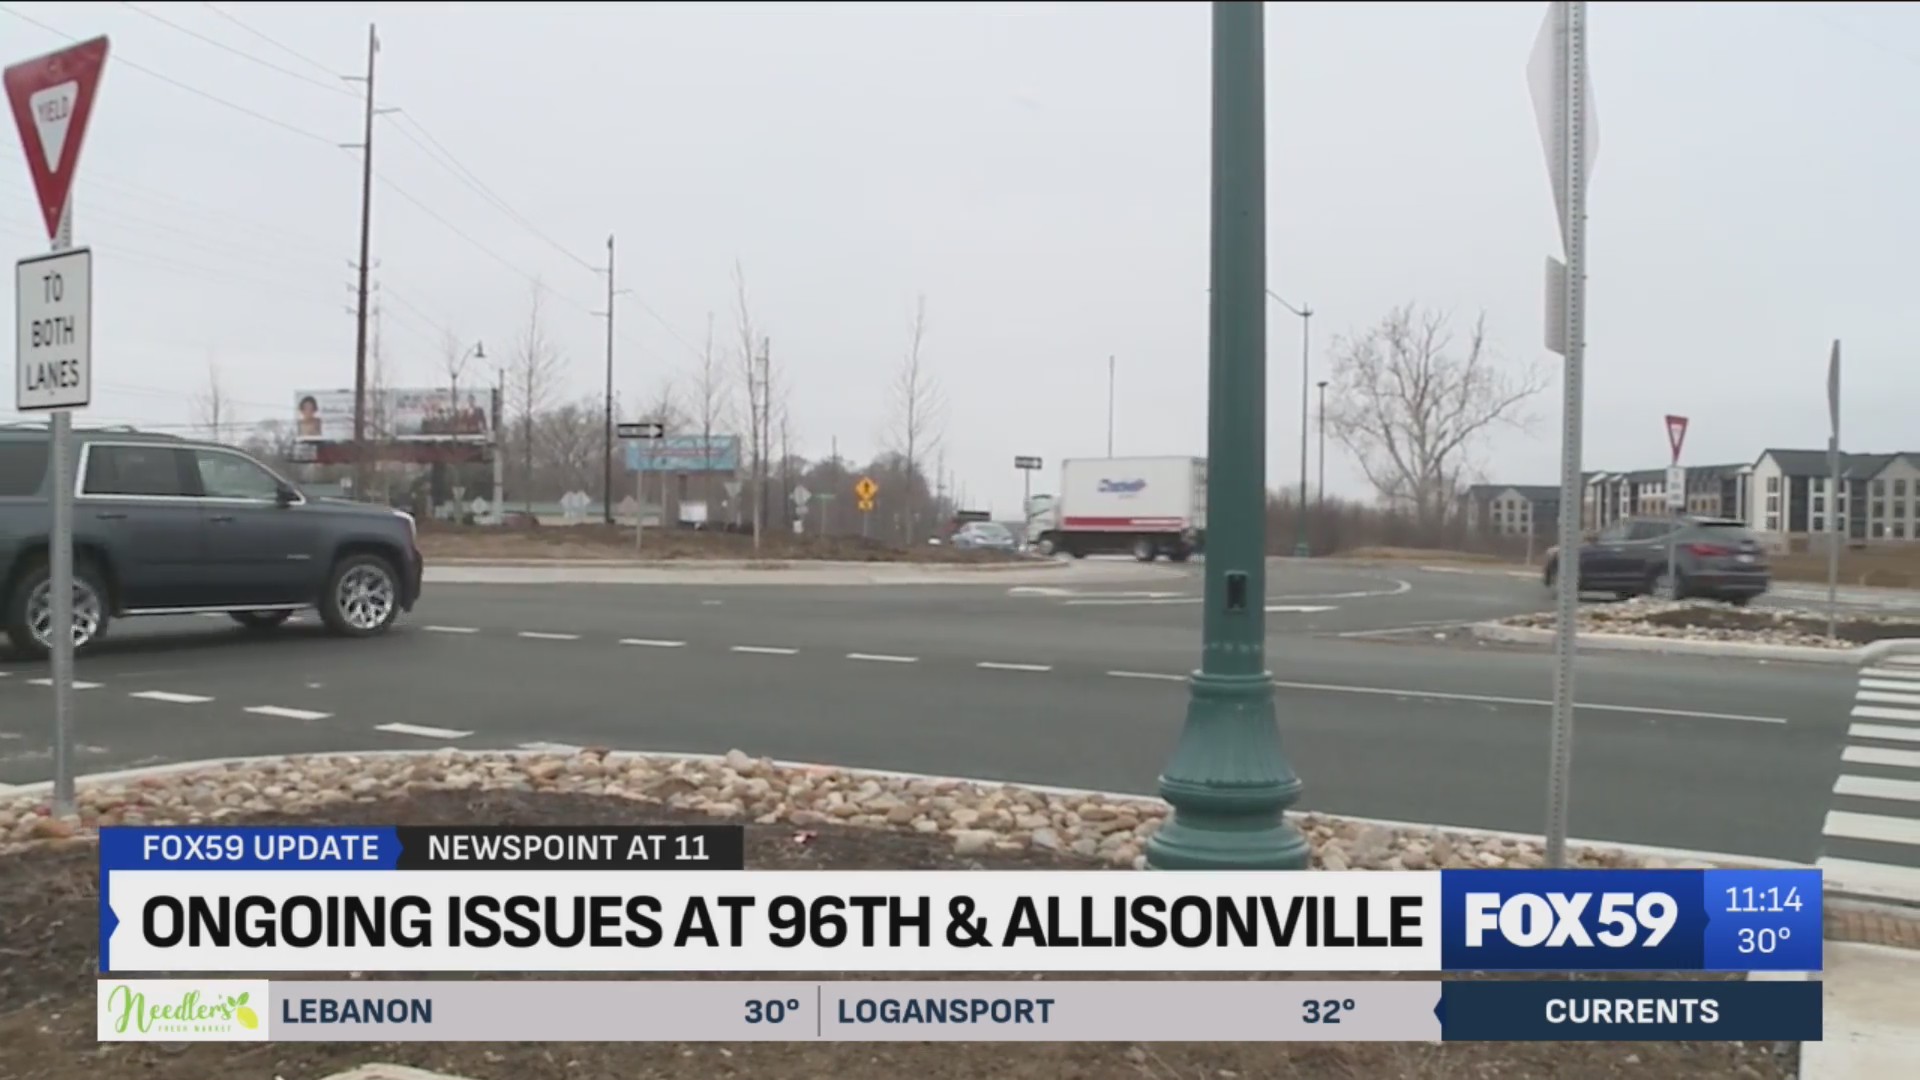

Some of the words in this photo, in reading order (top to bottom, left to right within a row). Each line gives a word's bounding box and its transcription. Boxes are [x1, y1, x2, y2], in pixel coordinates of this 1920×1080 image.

[37, 96, 69, 122] YIELD
[43, 273, 64, 303] TO
[32, 315, 74, 348] BOTH
[26, 359, 80, 391] LANES
